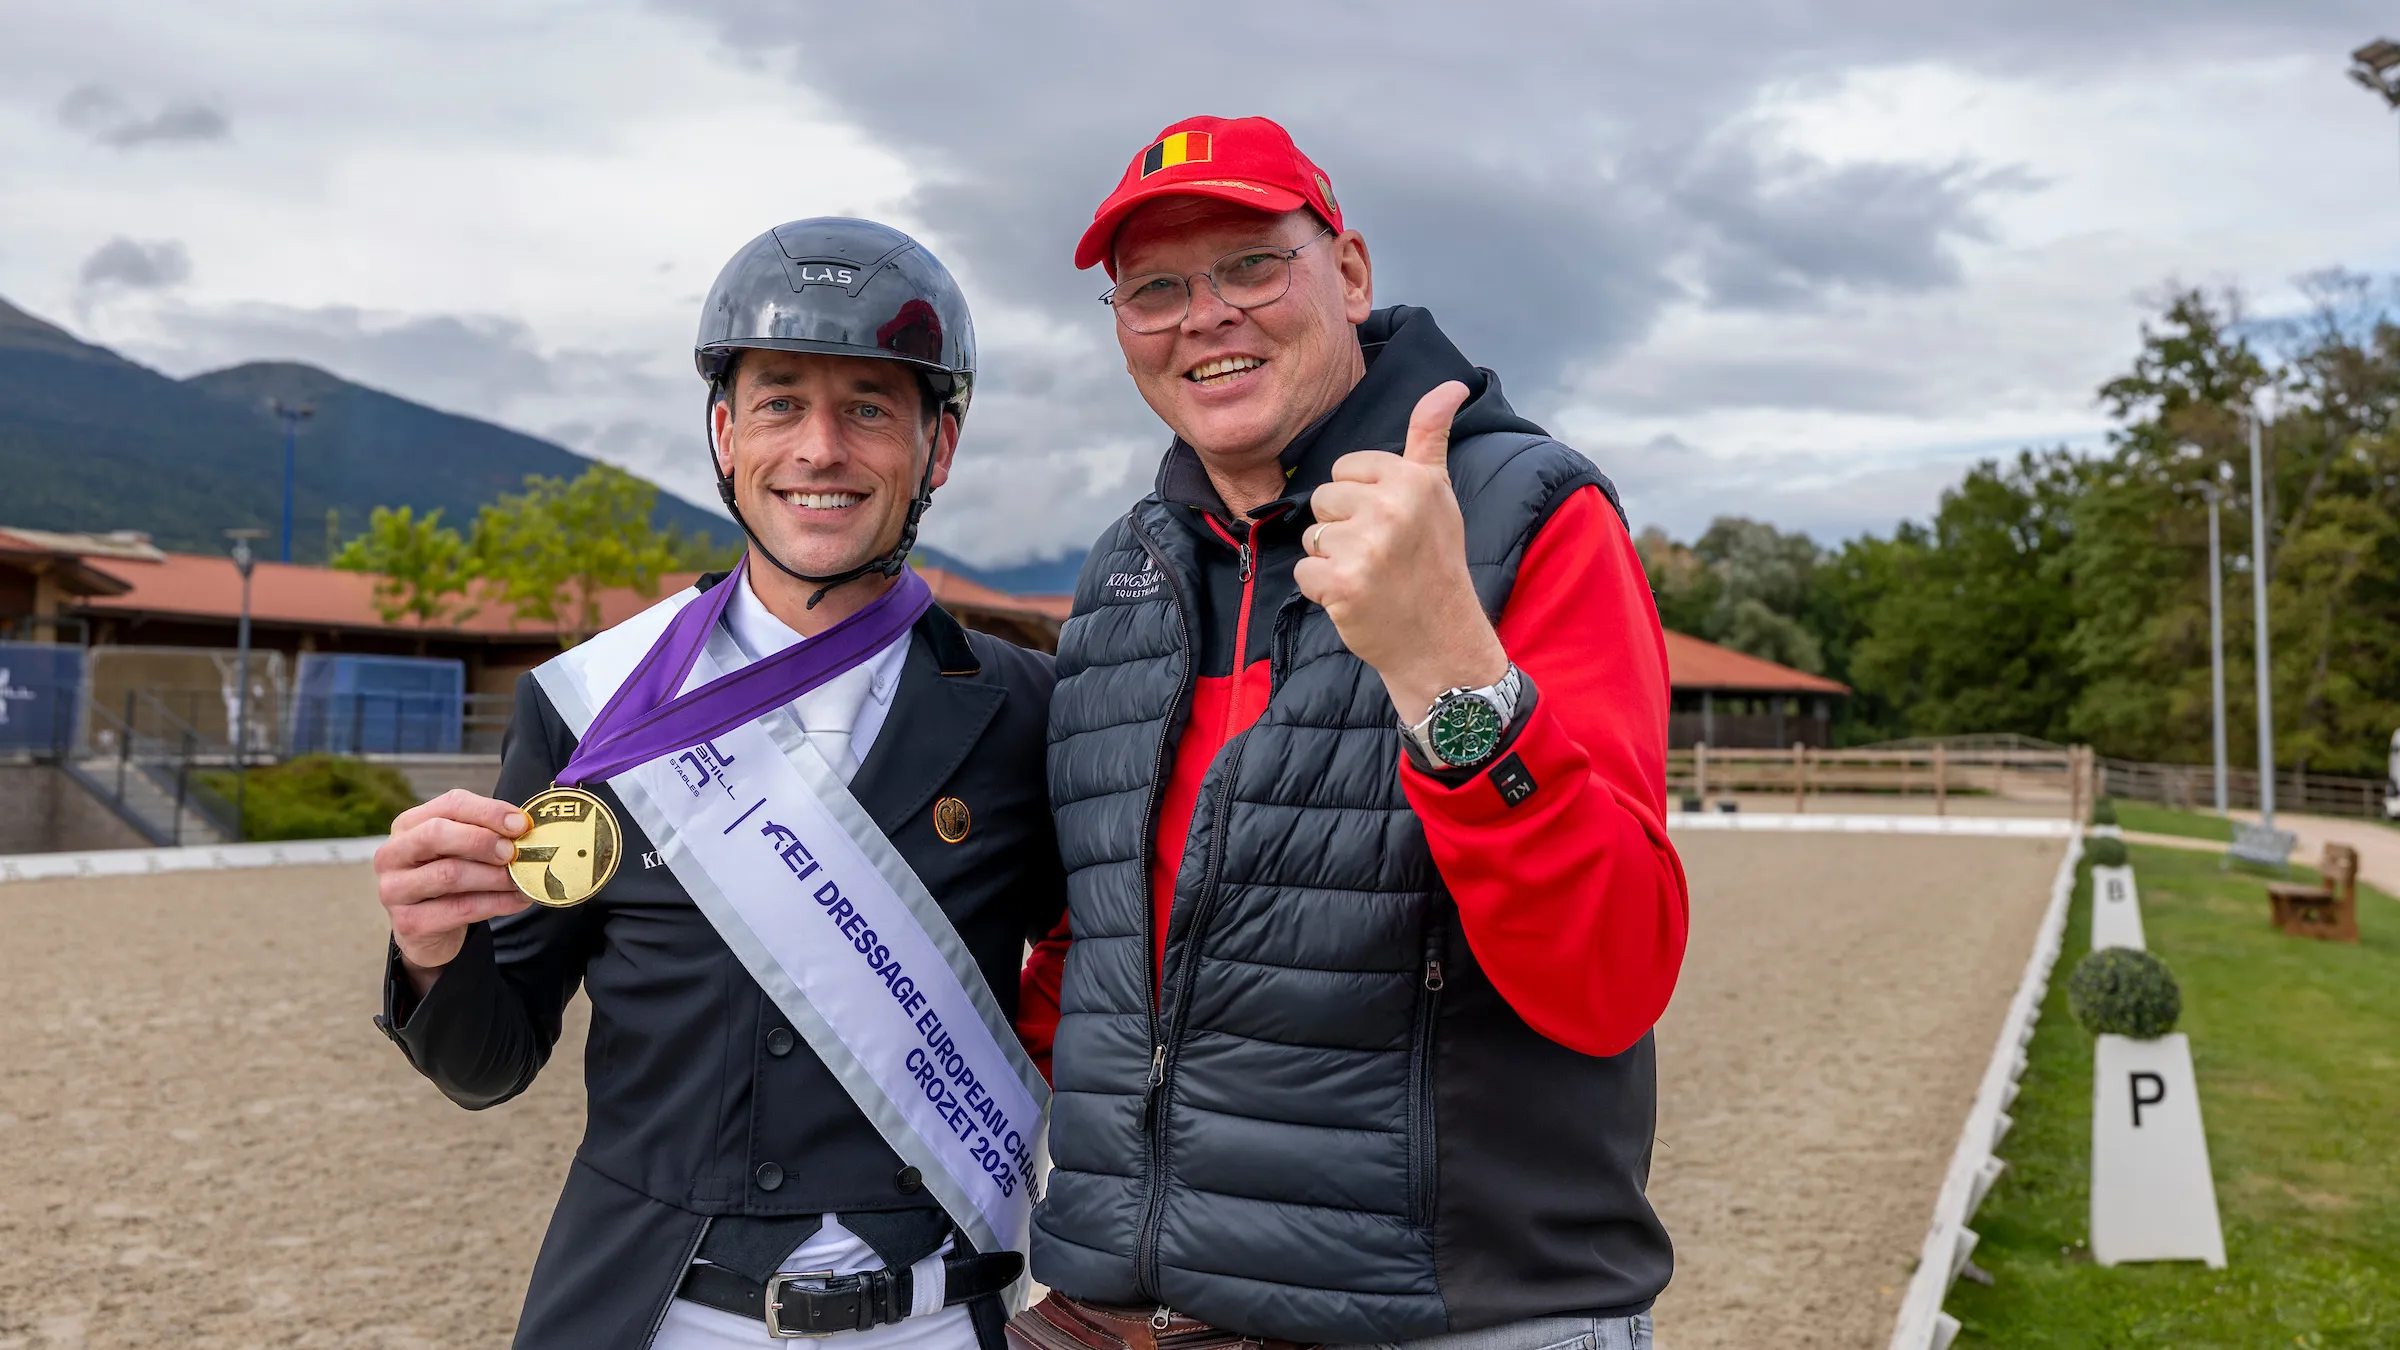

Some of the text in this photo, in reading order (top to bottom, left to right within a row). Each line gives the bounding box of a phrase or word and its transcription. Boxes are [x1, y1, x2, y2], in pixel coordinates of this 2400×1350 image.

[802, 267, 852, 284] LAS
[1105, 569, 1166, 587] KINGSLAN
[1115, 584, 1160, 598] EQUESTRIAN
[669, 758, 700, 798] STABLES
[695, 745, 736, 800] aHILL
[1507, 781, 1531, 800] KL
[538, 801, 582, 817] FEI
[641, 850, 664, 870] KI
[2106, 878, 2125, 902] B
[760, 820, 1041, 1209] FEI DRESSAGE EUROPEAN CHAMP
[2128, 1071, 2167, 1128] P
[905, 1048, 1018, 1198] CROZET 2025
